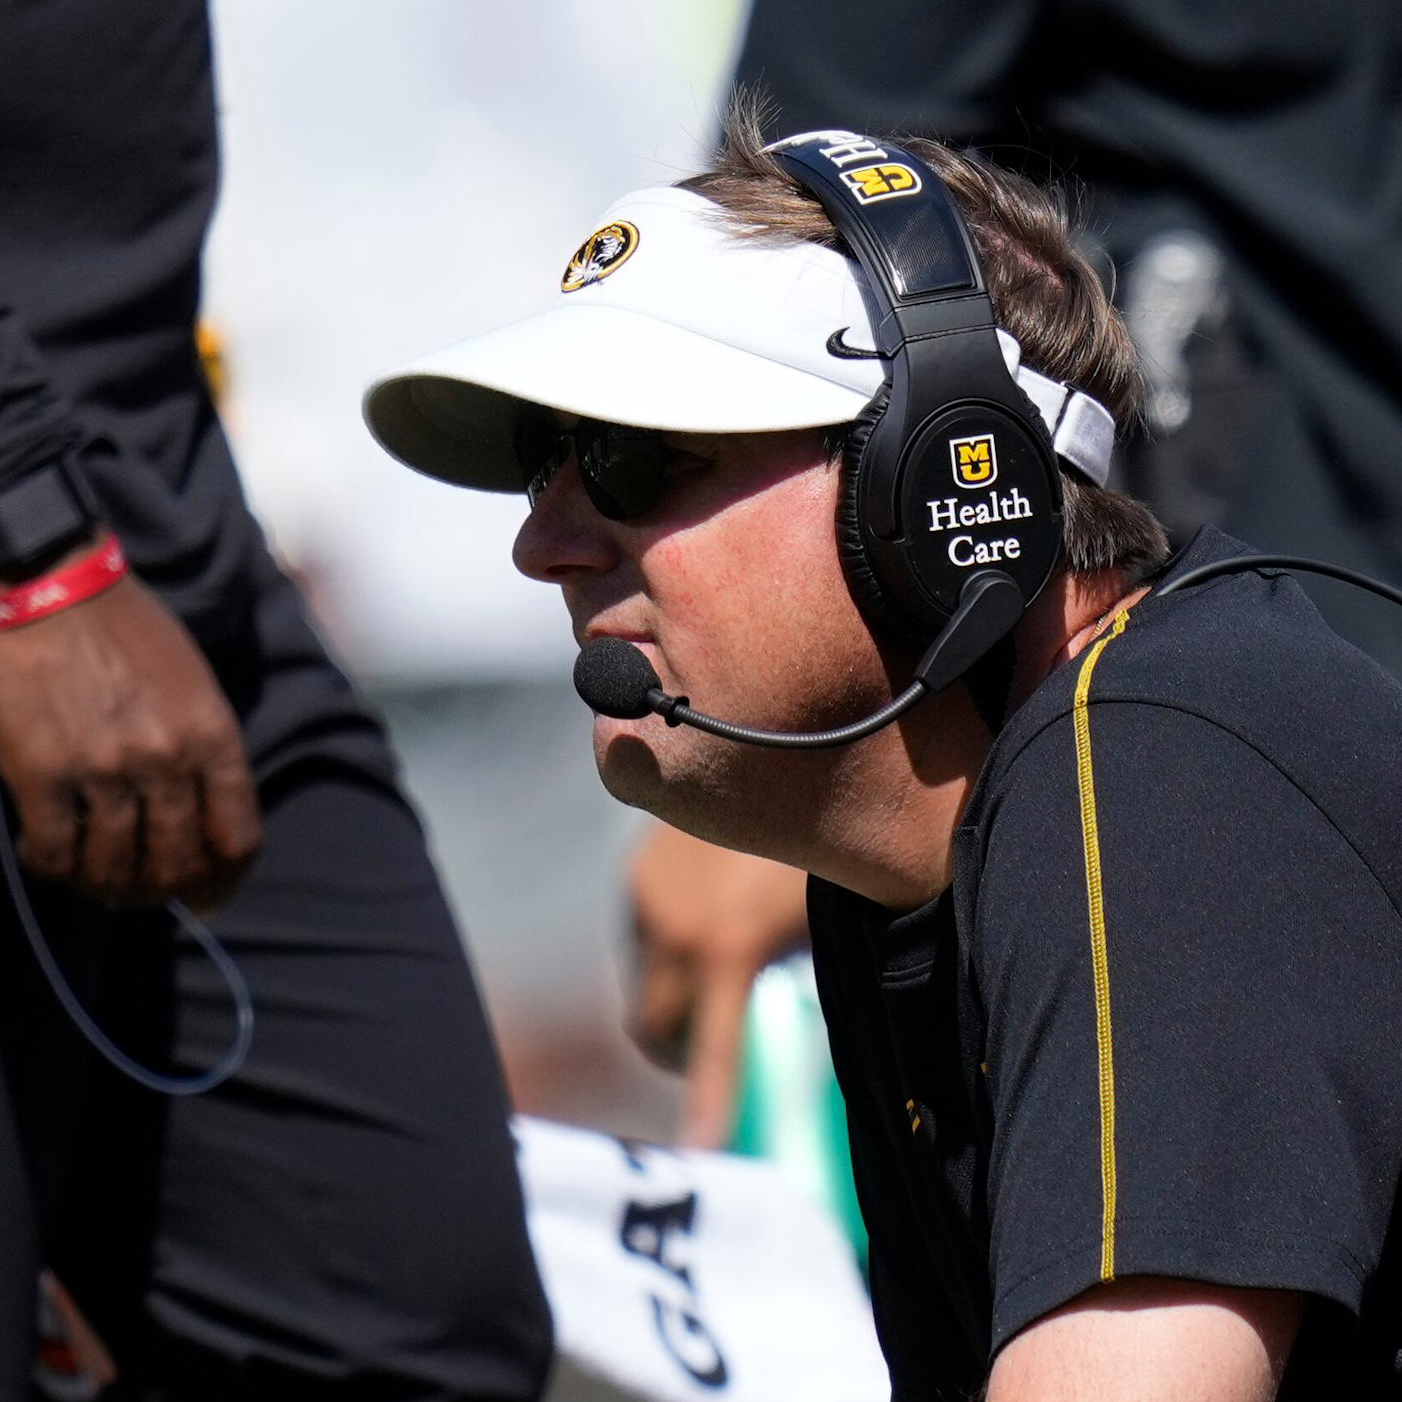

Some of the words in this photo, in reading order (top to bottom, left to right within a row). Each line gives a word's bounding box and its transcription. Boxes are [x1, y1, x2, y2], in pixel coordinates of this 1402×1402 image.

[956, 438, 992, 484] MU
[926, 488, 1033, 532] Health
[947, 535, 1022, 567] Care
